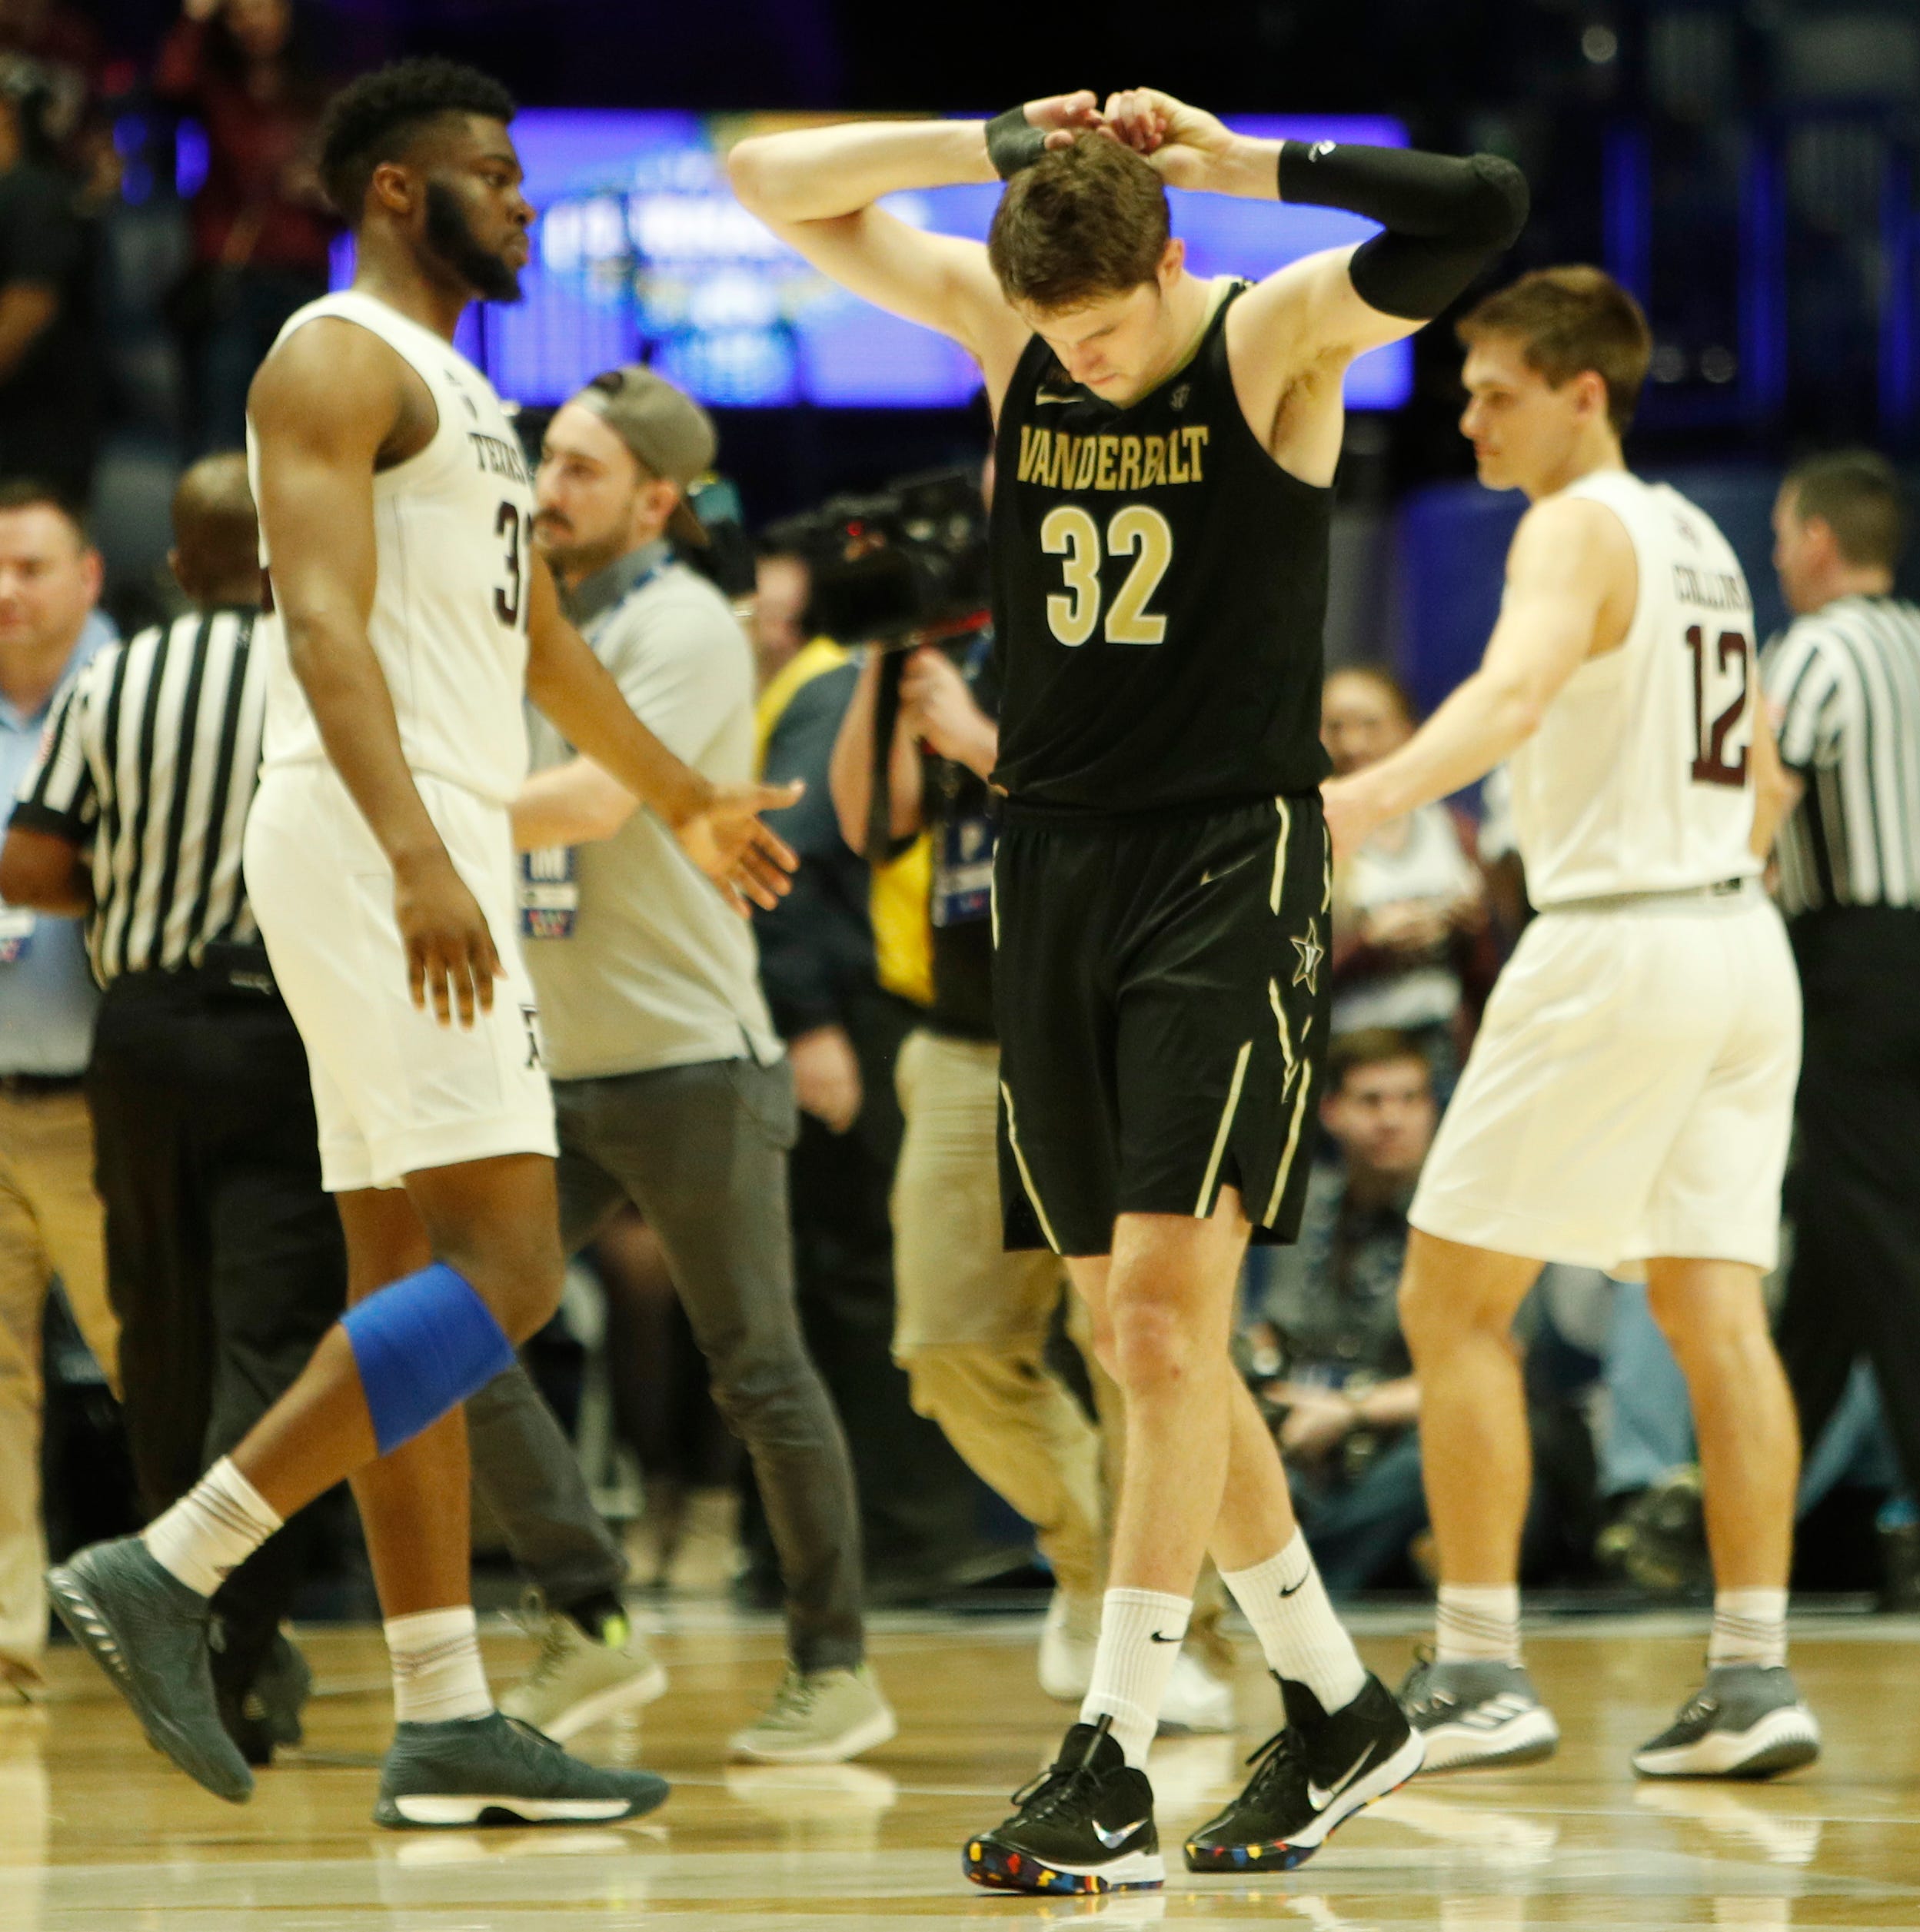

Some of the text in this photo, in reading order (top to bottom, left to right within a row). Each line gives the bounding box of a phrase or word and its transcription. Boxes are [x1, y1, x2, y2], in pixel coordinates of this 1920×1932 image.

[494, 500, 532, 634] 3
[1040, 504, 1173, 647] 32
[1685, 624, 1747, 787] 12
